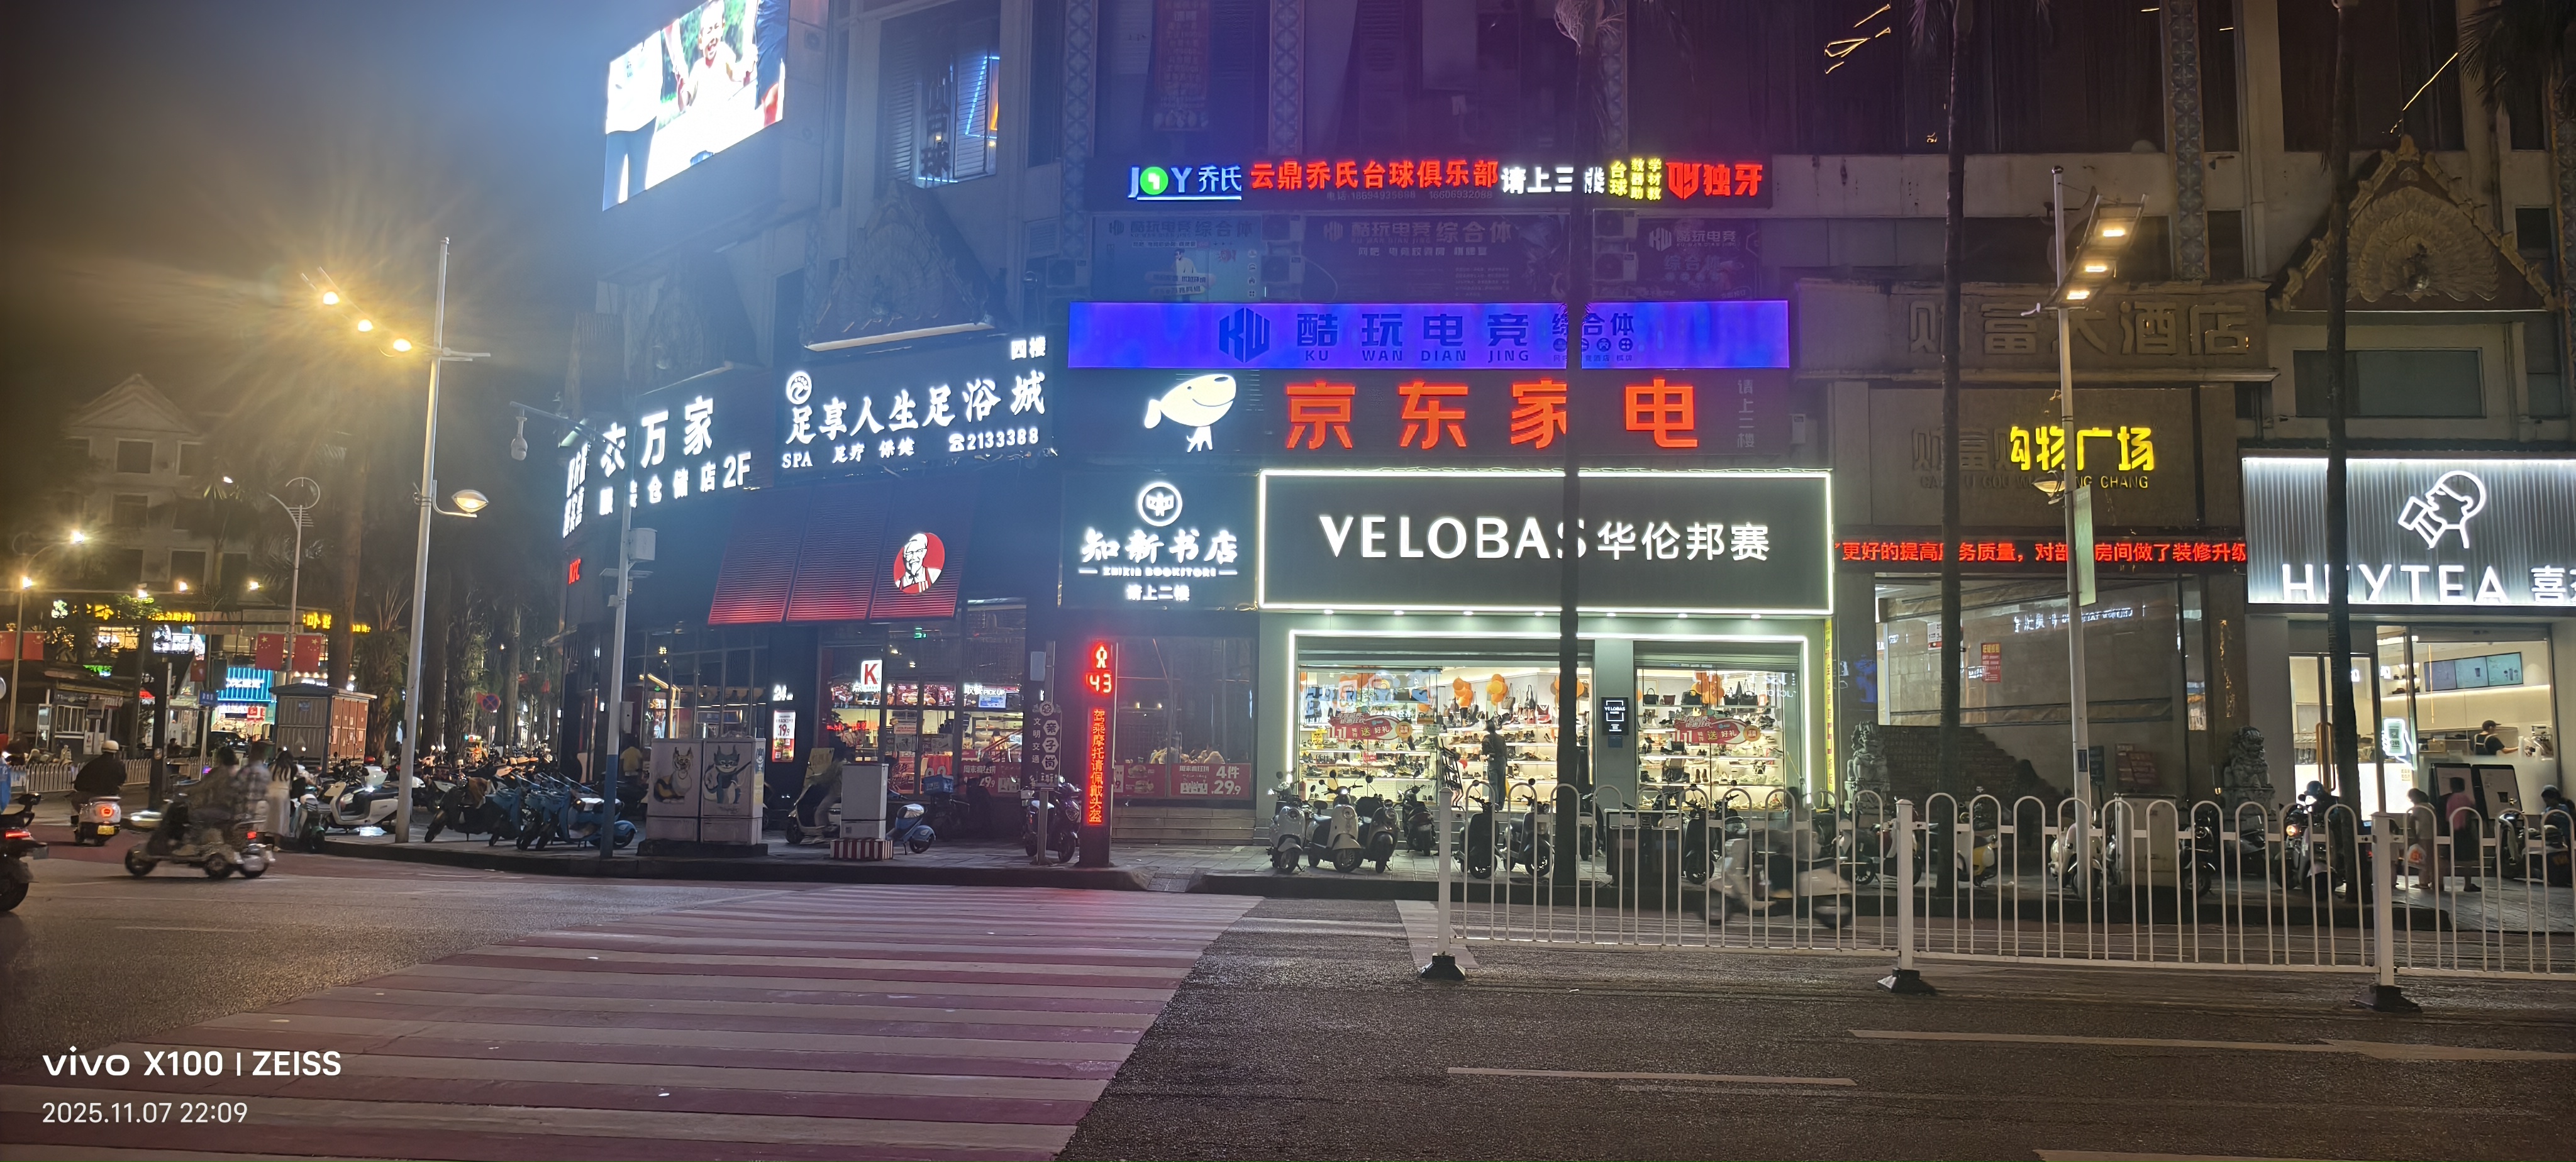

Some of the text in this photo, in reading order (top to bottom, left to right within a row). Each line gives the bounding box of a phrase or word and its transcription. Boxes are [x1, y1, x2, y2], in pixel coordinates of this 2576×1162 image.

[1198, 165, 1241, 192] 乔氏
[1250, 160, 1499, 190] 云鼎乔氏台球俱乐部
[1501, 165, 1604, 194] 请上三楼
[1609, 161, 1628, 196] 台球
[1704, 163, 1762, 196] 独牙
[1350, 221, 1512, 243] 酷玩电竞 综合体
[1297, 313, 1635, 347] 酷玩电竞 综合体
[1011, 335, 1046, 360] 四楼
[1305, 350, 1530, 362] KU WAN DIAN JING
[786, 370, 1046, 445] 足享人生足浴城
[1285, 379, 1698, 450] 京东家电
[1737, 379, 1755, 449] 请上二楼
[600, 395, 714, 478] 衣万家
[782, 426, 1039, 468] SPA 足疗 保健 2133388
[2100, 475, 2148, 489] CHANG
[1082, 527, 1238, 565] 知新书店
[1596, 521, 1771, 562] 华伦邦赛
[2282, 563, 2509, 603] HYTEA
[864, 663, 879, 685] K
[1090, 674, 1112, 693] 43
[1032, 717, 1041, 763] 文明交通
[1045, 722, 1057, 768] 亲子岗
[1089, 709, 1106, 823] 驾乘摩托请佩戴头盔
[1216, 765, 1240, 779] 4件
